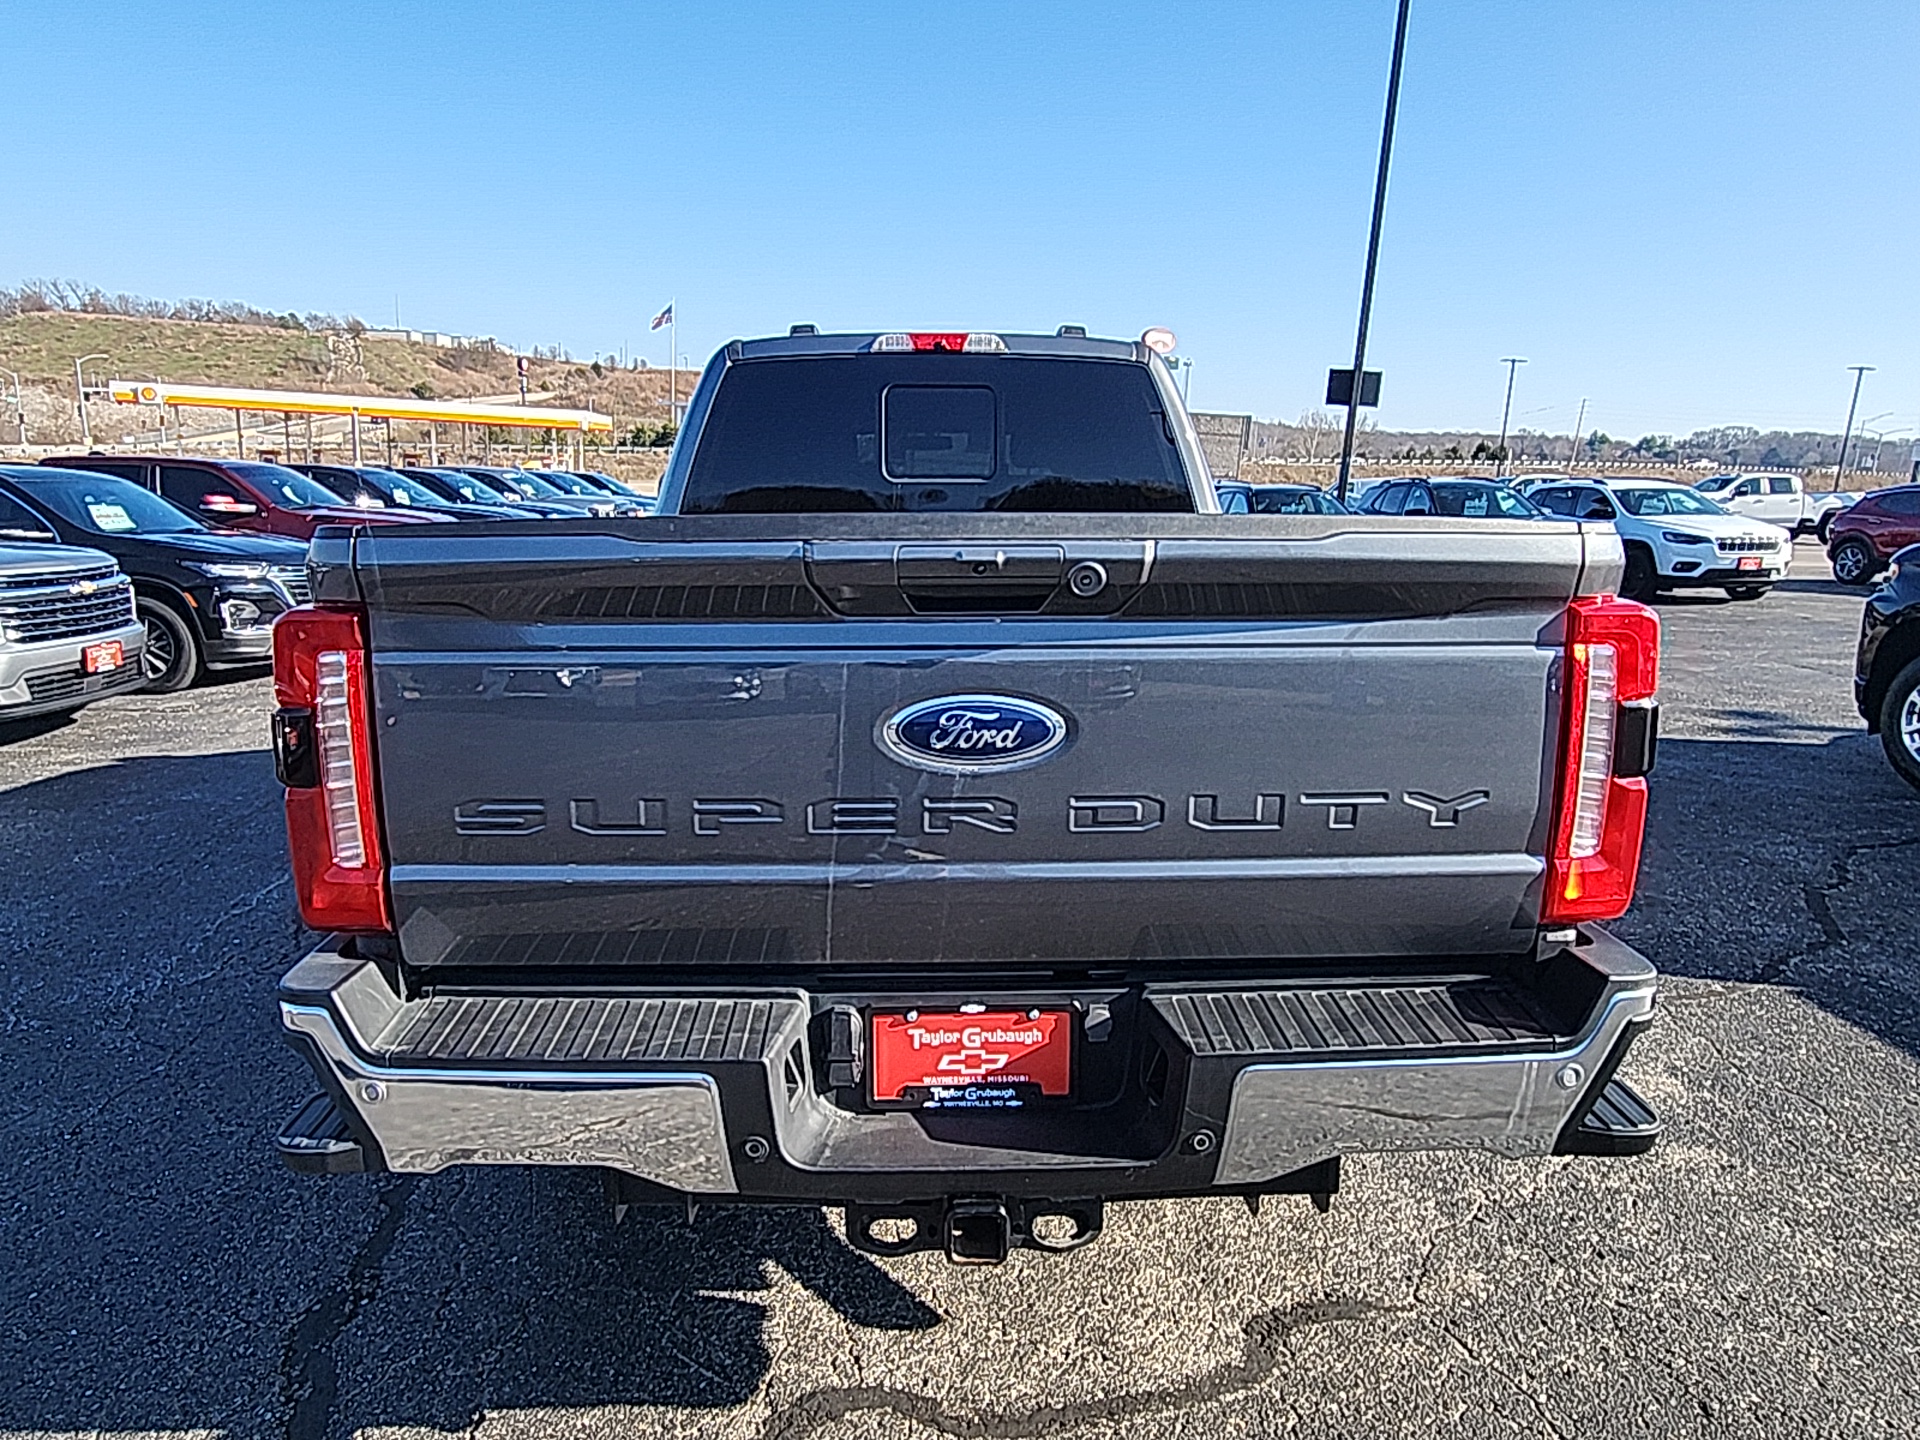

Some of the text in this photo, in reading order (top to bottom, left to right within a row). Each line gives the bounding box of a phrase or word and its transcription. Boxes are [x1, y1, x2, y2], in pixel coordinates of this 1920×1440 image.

[929, 710, 1023, 749] Ford
[453, 789, 1491, 836] SUPER DUTY
[907, 1027, 1042, 1049] Taylor Grubaugh
[987, 1075, 1029, 1083] MISSOURI
[929, 1087, 1016, 1101] Taylor Grubaugh
